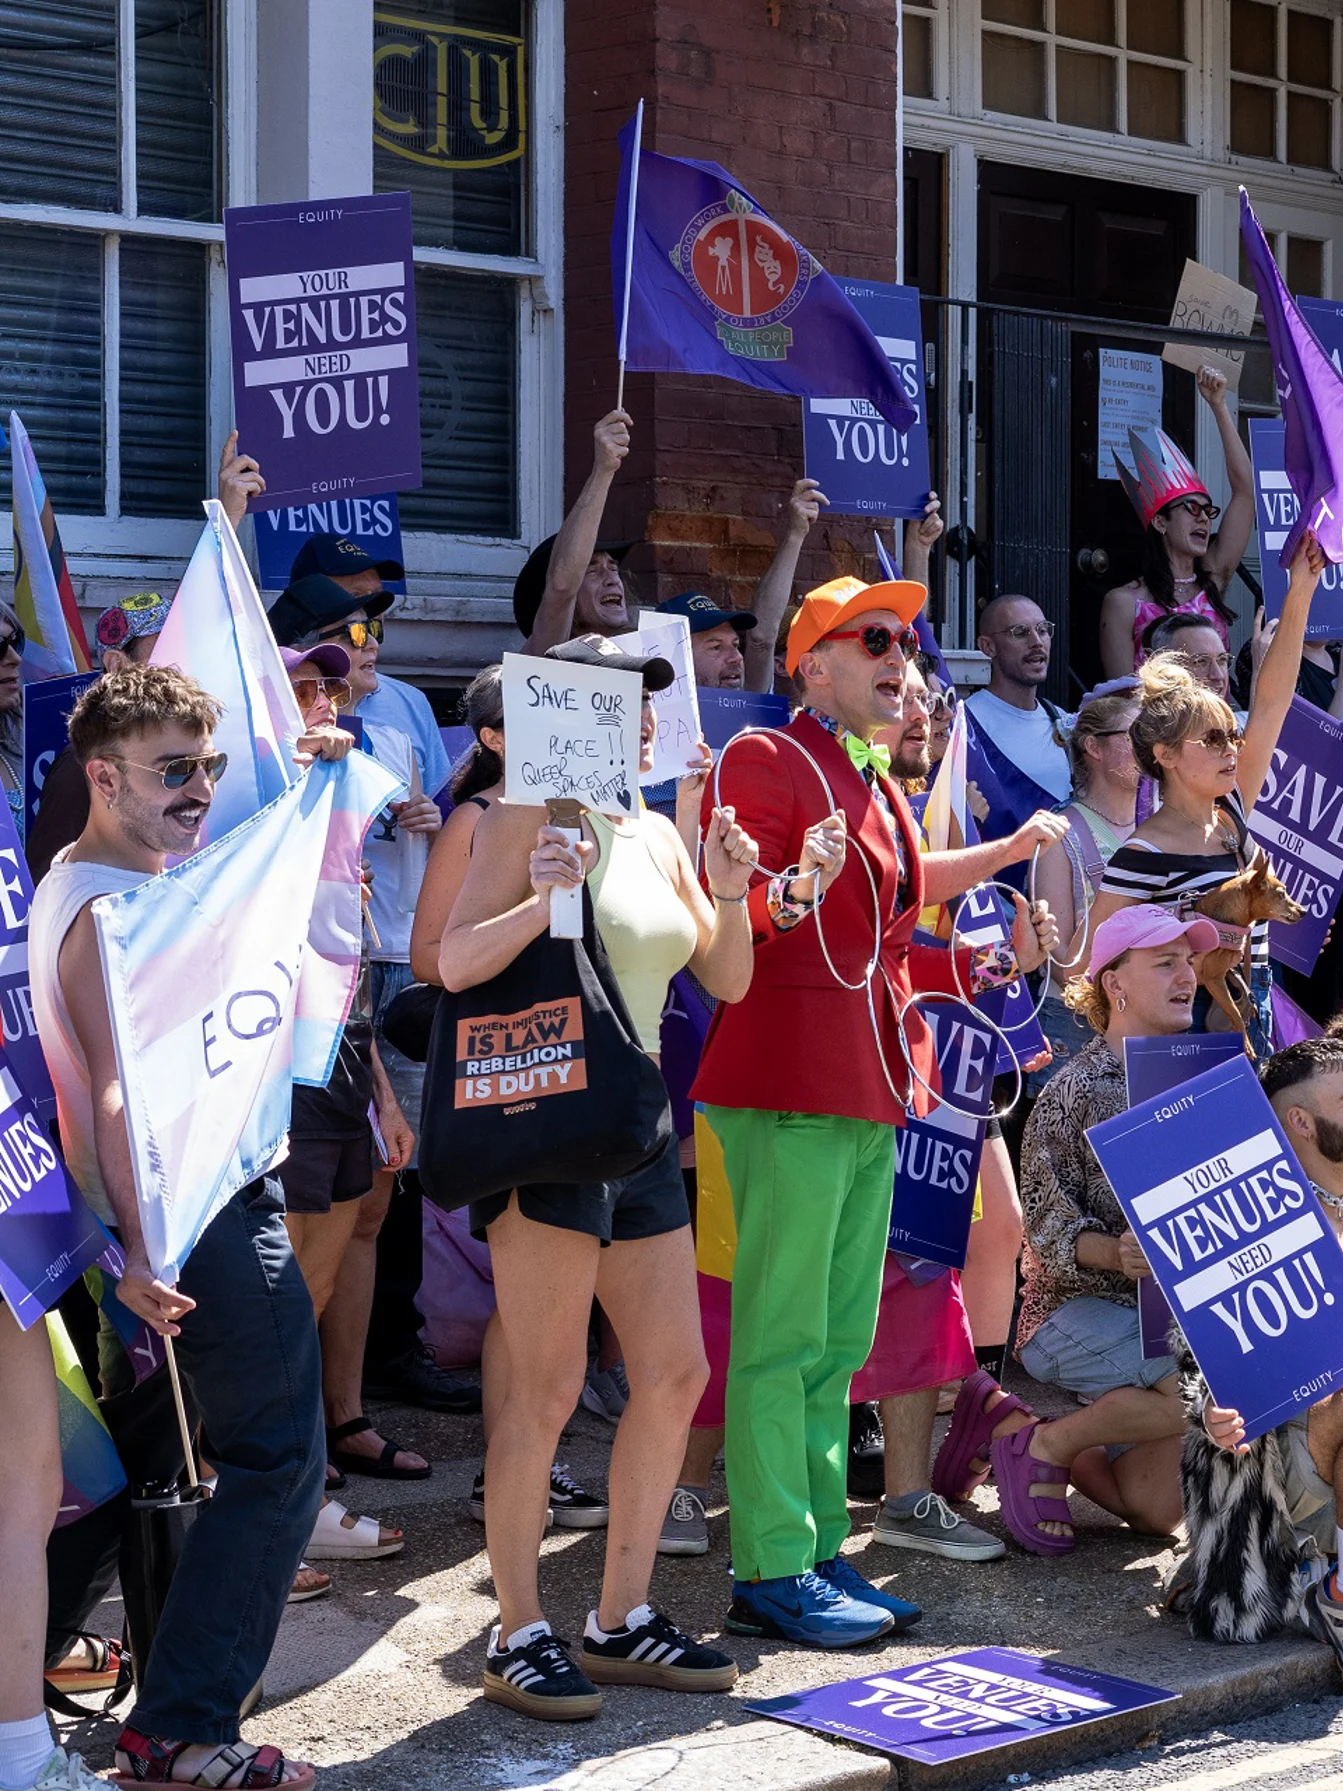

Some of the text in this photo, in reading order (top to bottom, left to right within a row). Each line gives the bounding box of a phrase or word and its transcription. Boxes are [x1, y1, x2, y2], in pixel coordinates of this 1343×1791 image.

[298, 210, 344, 223] EQUITY
[297, 270, 349, 294] YOUR
[844, 286, 874, 298] EQUITY
[242, 292, 407, 351] VENUES
[748, 331, 789, 342] PEOPLE
[303, 354, 351, 377] NEED
[1102, 355, 1153, 373] POLITE NOTICE
[270, 375, 391, 438] YOU!
[850, 400, 881, 417] NEE
[827, 418, 909, 467] YOU!
[311, 477, 356, 493] EQUITY
[266, 500, 394, 536] VENUES
[857, 499, 887, 510] EQUITY
[526, 675, 625, 715] SAVE OUR
[718, 697, 747, 709] EQUITY
[549, 736, 600, 758] PLACE
[521, 757, 568, 787] QUEER
[552, 772, 602, 798] SPACES
[1278, 828, 1304, 856] OUR
[469, 1005, 569, 1034] WHEN INJUSTICE
[467, 1017, 568, 1057] IS LAW
[1170, 1043, 1200, 1056] EQUITY
[466, 1043, 572, 1076] REBELLION
[924, 1010, 992, 1101] VE
[465, 1063, 573, 1100] IS DUTY
[1154, 1094, 1196, 1124] EQUITY
[1183, 1156, 1234, 1196] YOUR
[1146, 1159, 1305, 1272] VENUES
[46, 1251, 72, 1282] EQUITY
[1227, 1242, 1273, 1281] NEED
[1209, 1251, 1336, 1355] YOU!
[1292, 1369, 1335, 1402] EQUITY
[903, 1667, 1091, 1723] VENUES
[849, 1689, 993, 1736] YOU!
[824, 1719, 876, 1740] EQUITY
